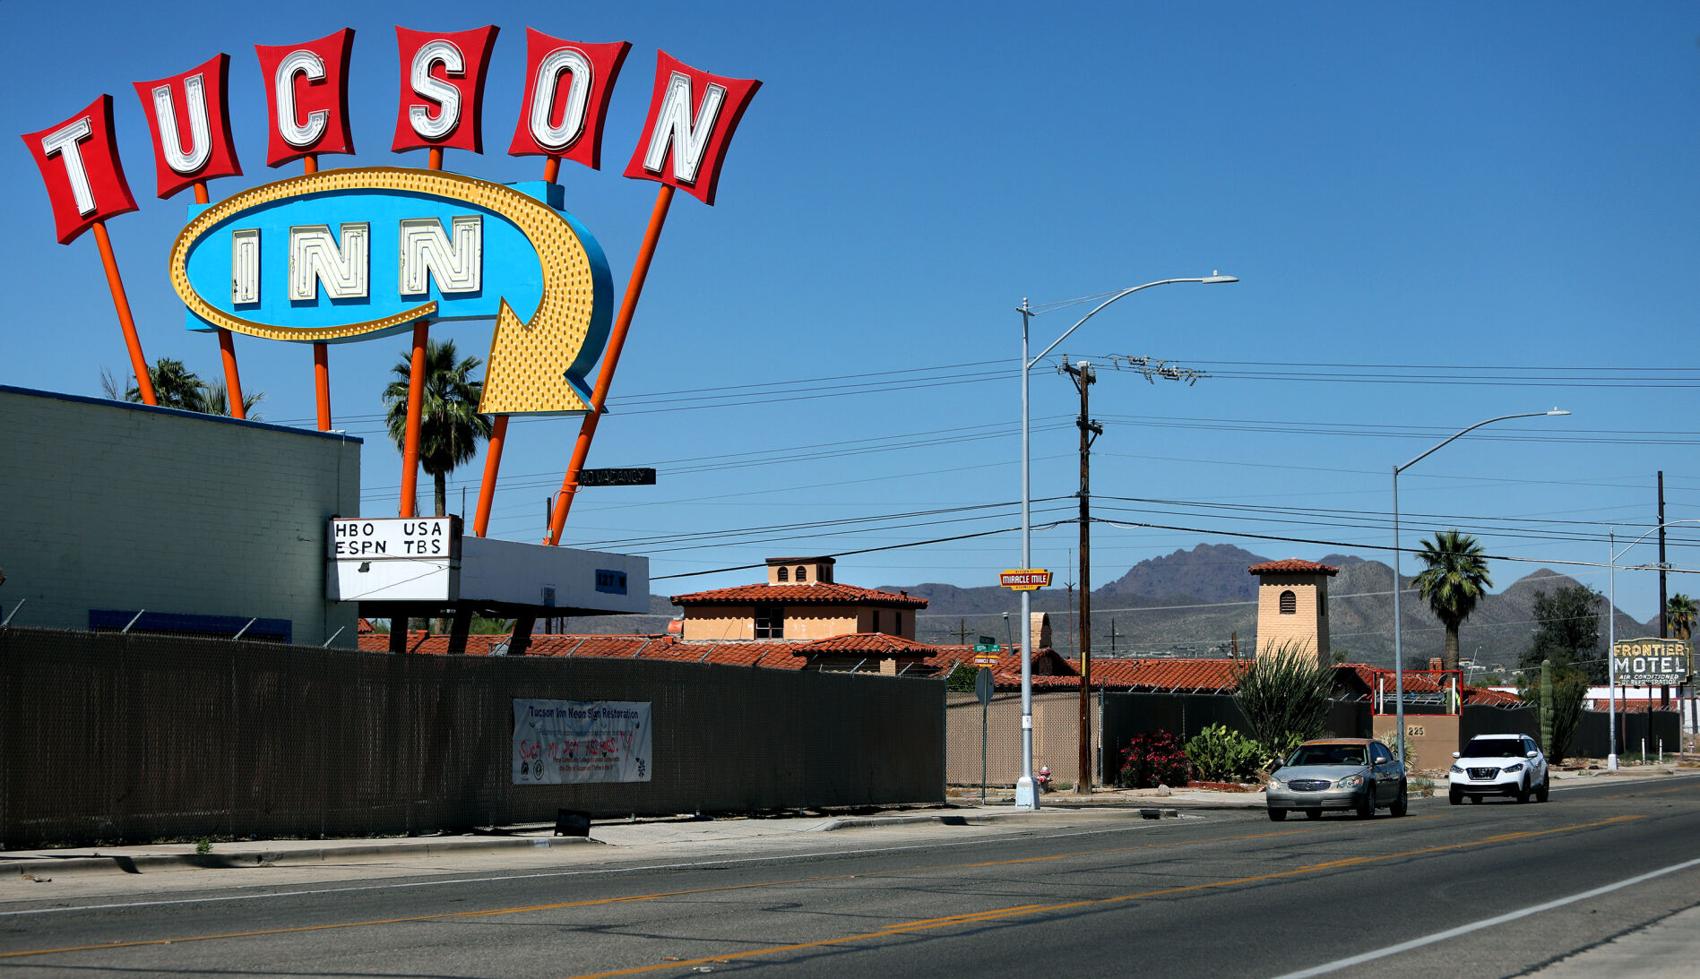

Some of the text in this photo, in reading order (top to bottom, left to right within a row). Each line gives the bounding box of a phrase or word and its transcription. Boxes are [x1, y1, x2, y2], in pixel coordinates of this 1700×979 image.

[41, 39, 727, 217] TUCSON
[231, 215, 484, 305] INN
[335, 522, 442, 537] HBO USA
[335, 539, 441, 554] ESPN TBS
[1002, 574, 1047, 584] MIRACLE MILE
[1614, 643, 1685, 657] FRONTIER
[1614, 657, 1686, 673] MOTEL
[529, 706, 639, 721] Tucson Inn Neon Sign Restoration
[1408, 726, 1424, 736] 225
